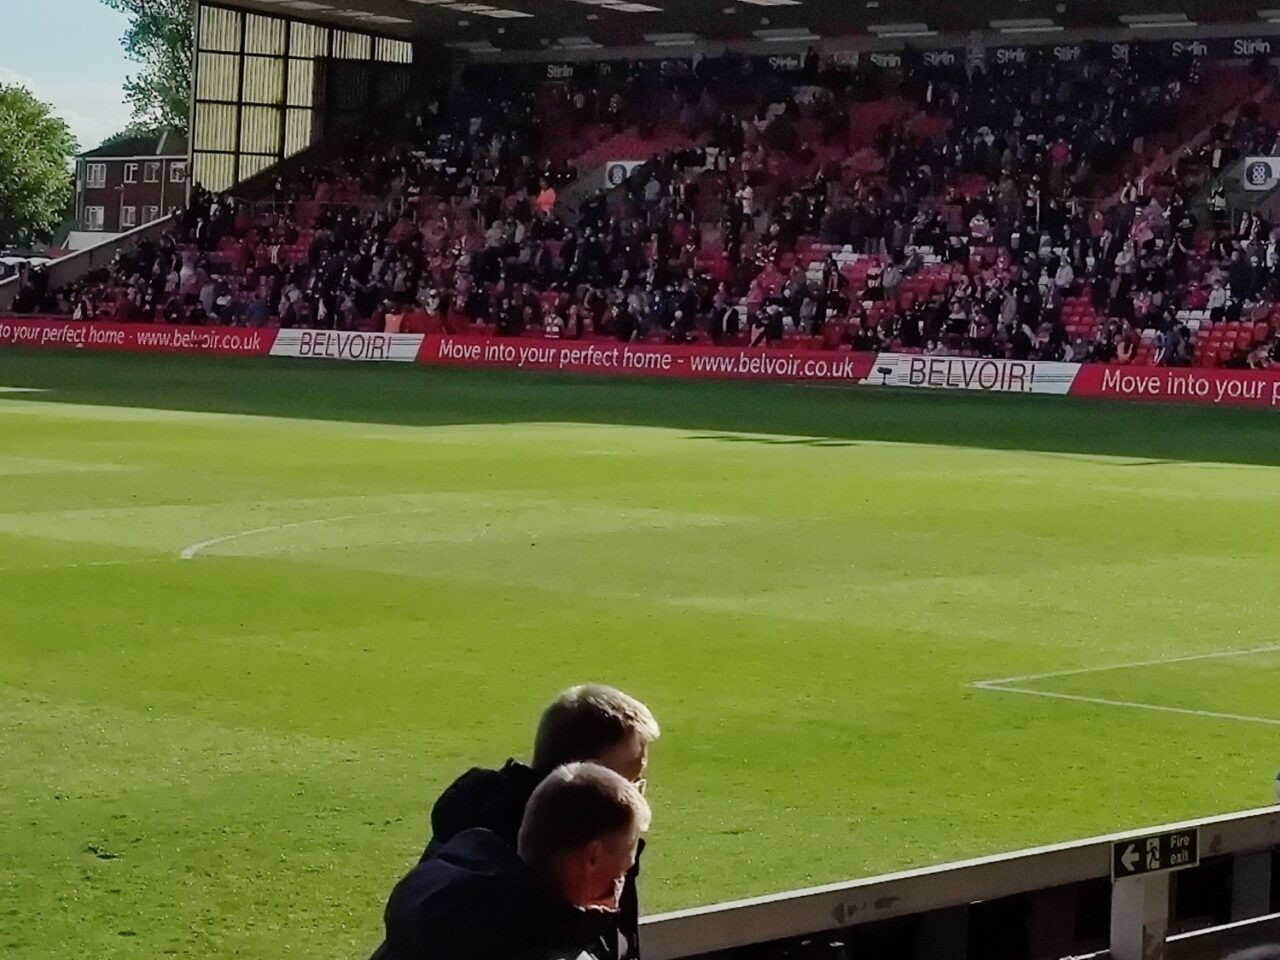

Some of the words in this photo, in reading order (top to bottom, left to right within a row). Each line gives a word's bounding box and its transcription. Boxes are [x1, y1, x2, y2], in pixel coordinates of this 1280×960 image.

[12, 326, 41, 343] your
[41, 325, 86, 345] perfect
[88, 325, 125, 344] home
[301, 332, 391, 359] BELVOIR!
[438, 339, 481, 360] Move
[484, 340, 516, 361] into
[518, 346, 557, 366] your
[559, 344, 618, 368] perfect
[623, 346, 671, 369] home
[690, 347, 855, 378] www.belvoir.co.uk
[909, 358, 1035, 391] BELVOIR!
[1102, 369, 1160, 394] Move
[1167, 370, 1210, 396] into
[1214, 377, 1267, 402] your
[1170, 835, 1190, 848] Fire
[1170, 851, 1189, 865] exit
